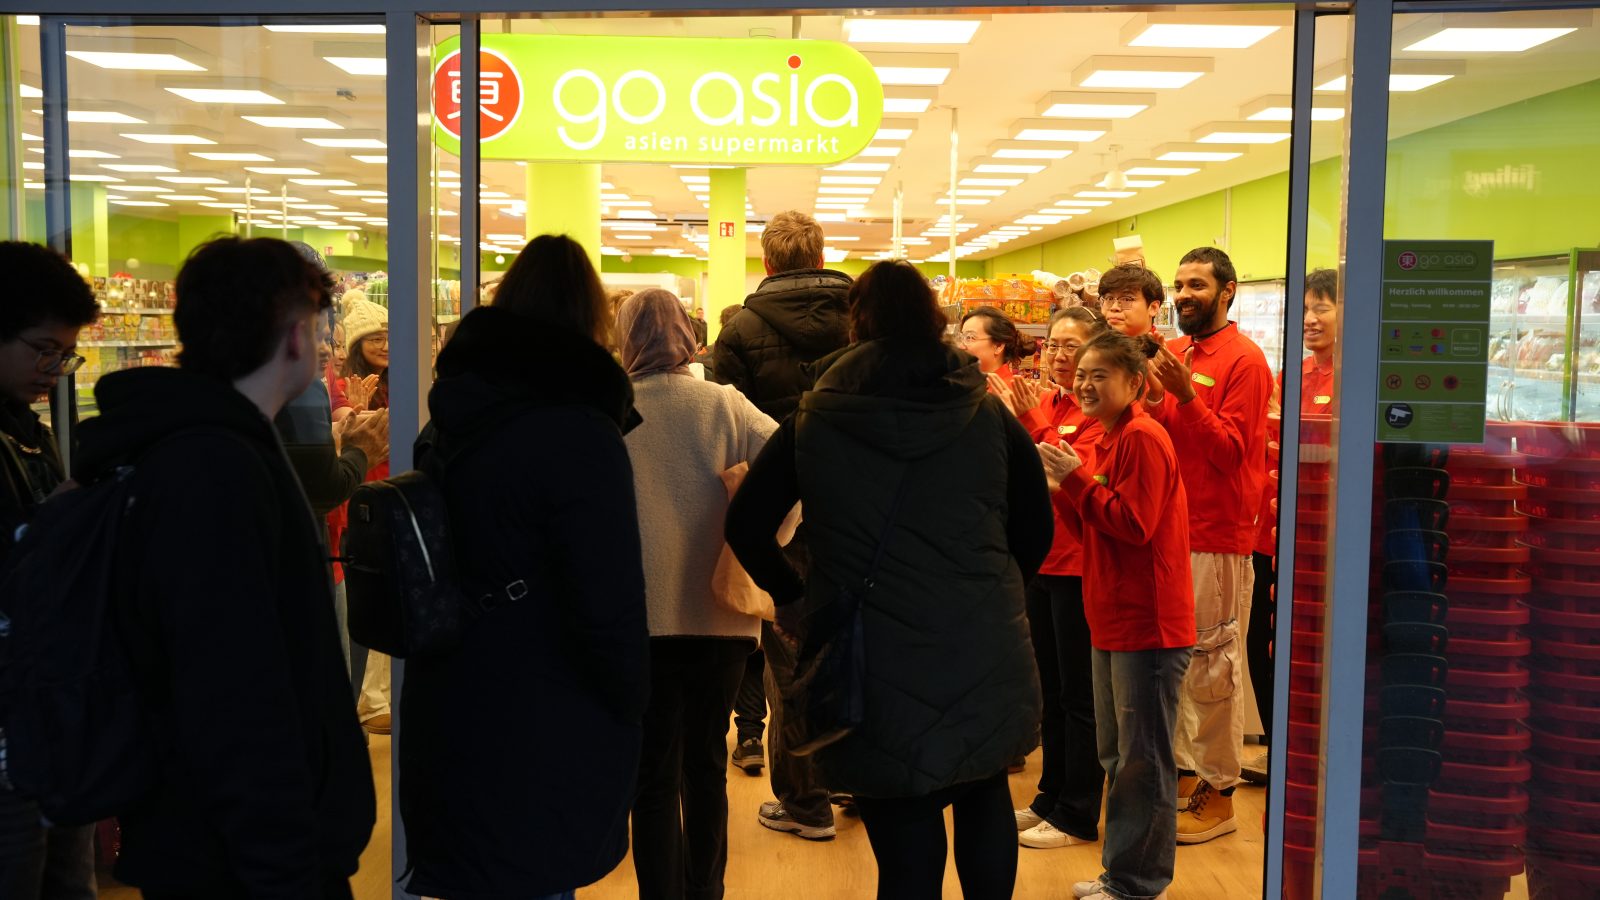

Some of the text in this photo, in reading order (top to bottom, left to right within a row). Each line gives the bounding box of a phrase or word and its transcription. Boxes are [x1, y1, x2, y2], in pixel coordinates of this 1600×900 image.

[553, 54, 859, 151] go asia
[625, 131, 839, 157] asien supermarkt
[1420, 253, 1474, 269] go asia
[1389, 287, 1484, 297] Herzlich willkommen
